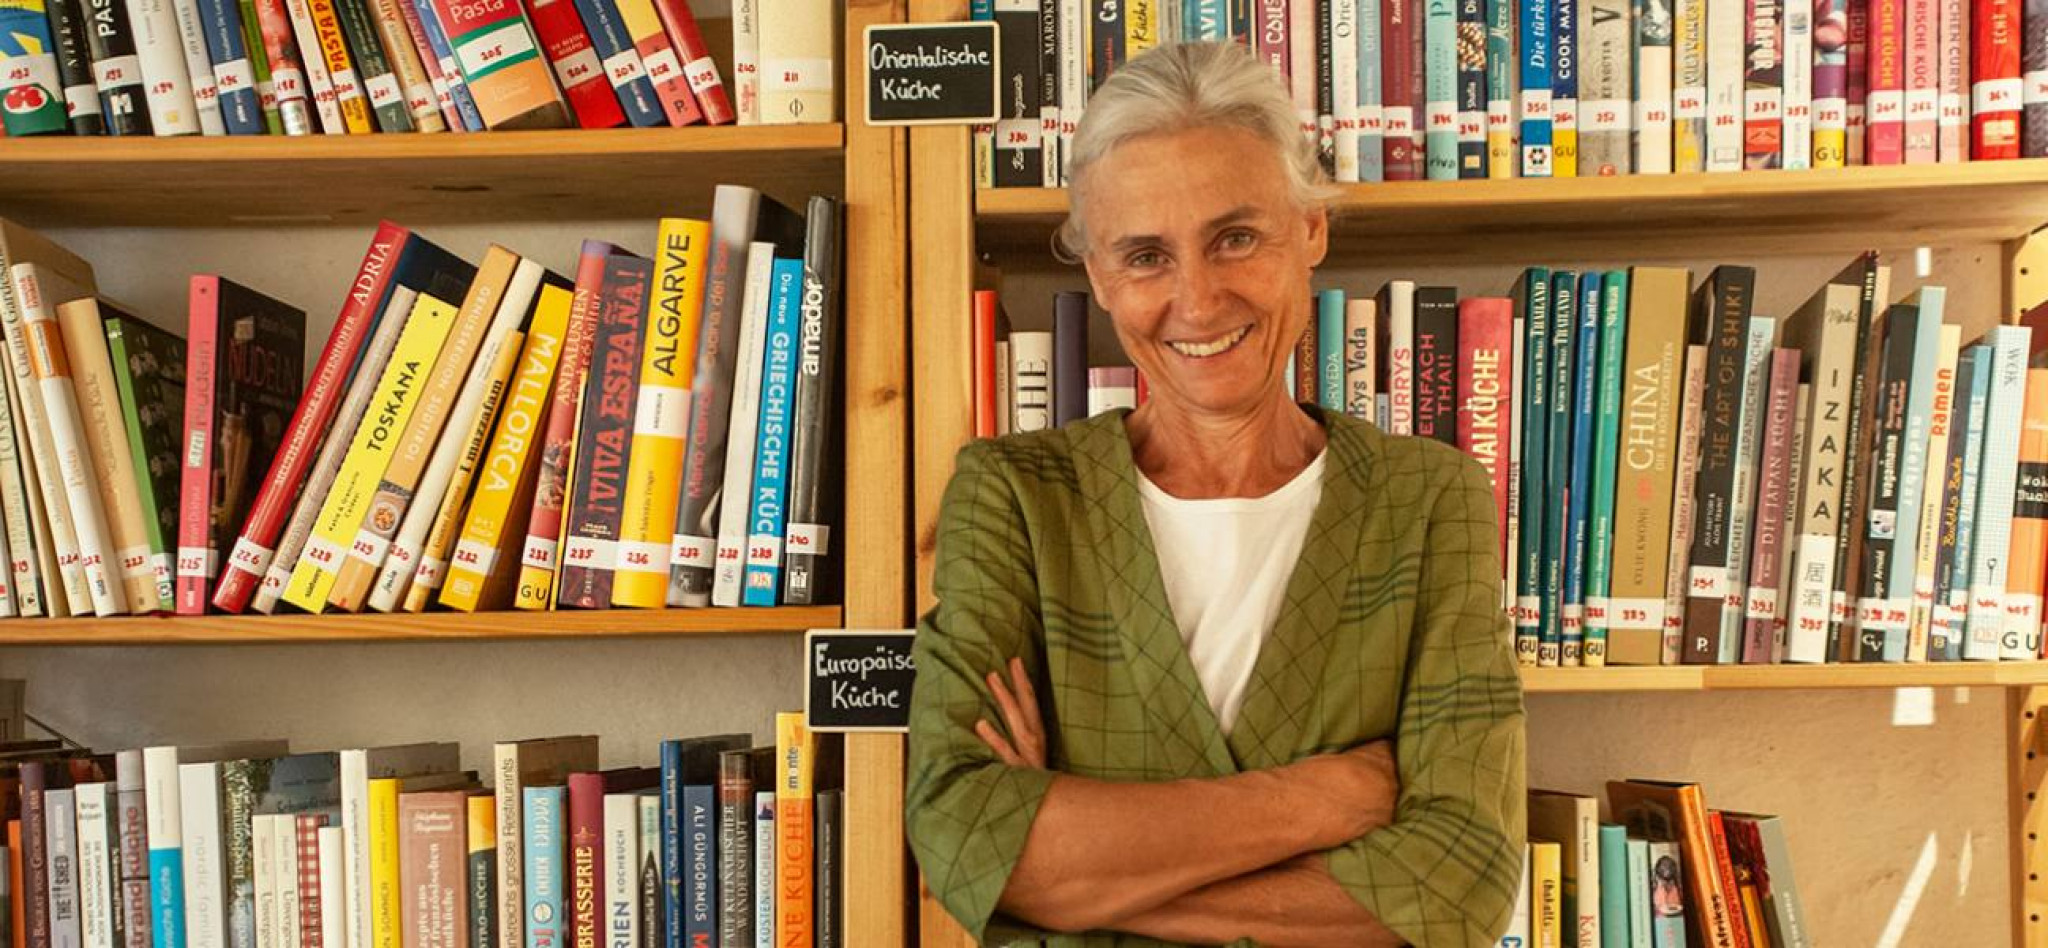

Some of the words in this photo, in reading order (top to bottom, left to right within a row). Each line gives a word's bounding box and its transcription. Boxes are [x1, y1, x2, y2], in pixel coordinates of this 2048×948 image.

[323, 22, 350, 73] PASTA
[871, 43, 990, 70] Orientalische
[1531, 38, 1546, 69] Die
[1558, 33, 1571, 80] COOK
[881, 79, 943, 100] Küche
[1554, 146, 1575, 157] GU
[1815, 147, 1842, 159] GU
[353, 241, 394, 306] ADRIA
[781, 272, 794, 294] Die
[653, 233, 691, 377] ALGARVE
[777, 296, 790, 325] neue
[1721, 282, 1744, 350] SHIKI
[556, 287, 590, 406] ANDALUSIEN
[802, 277, 824, 378] amador
[1348, 326, 1368, 375] Veda
[1718, 354, 1738, 385] OF
[366, 360, 421, 452] TOSKANA
[761, 331, 791, 481] GRIECHISCHE
[1392, 347, 1411, 437] CURRYS
[1419, 333, 1435, 436] EINFACH
[1465, 348, 1500, 430] KÜCHE
[1930, 367, 1954, 437] Ramen
[484, 332, 558, 493] MALLORCA
[1627, 362, 1664, 470] CHINA
[1714, 388, 1735, 428] ART
[1709, 432, 1733, 472] THE
[754, 486, 780, 538] KÜC
[236, 549, 261, 566] 226
[521, 584, 549, 601] GU
[1520, 637, 1538, 652] GU
[1540, 646, 1558, 660] GU
[1564, 644, 1581, 657] GU
[1586, 641, 1603, 657] GU
[2001, 631, 2041, 651] GU
[832, 680, 900, 709] Küche
[502, 757, 517, 838] Restaurants
